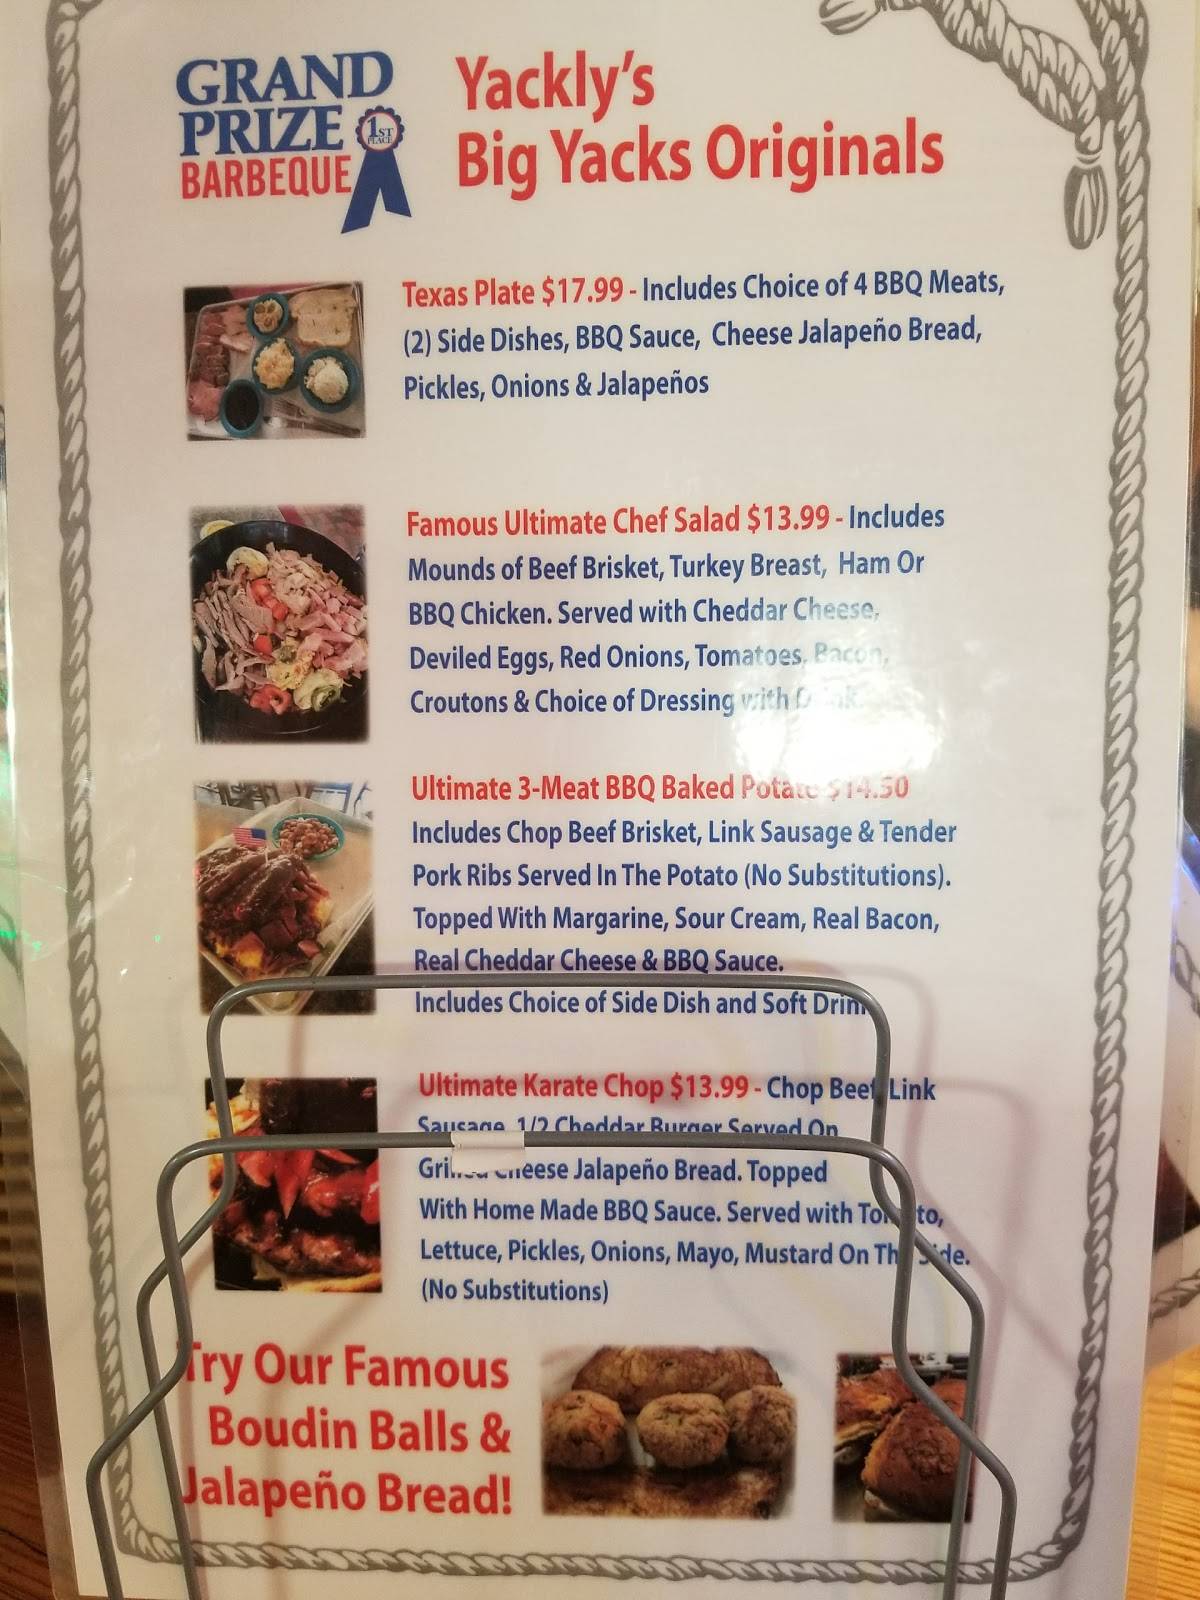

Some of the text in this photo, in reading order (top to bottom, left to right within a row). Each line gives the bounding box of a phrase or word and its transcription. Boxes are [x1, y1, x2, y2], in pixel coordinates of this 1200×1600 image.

[177, 51, 393, 105] GRAND
[456, 50, 654, 123] Yackly's
[179, 105, 343, 156] PRIZE
[459, 117, 944, 201] Big Yacks Originals
[182, 155, 351, 199] BARBEQUE
[402, 281, 468, 307] Texas
[475, 278, 534, 305] Plate
[543, 276, 623, 307] $17.99
[644, 275, 736, 301] Includes
[744, 273, 819, 298] Choice
[826, 271, 848, 296] of
[854, 272, 867, 295] 4
[875, 270, 922, 297] BBQ
[930, 270, 1004, 295] Meats,
[404, 315, 981, 357] (2) Side Dishes, BBQ Sauce, Cheese Jalapeño Bread,
[405, 370, 708, 402] Pickles, Onions & Jalapeños
[408, 512, 498, 536] Famous
[505, 509, 606, 535] Ultimate
[614, 506, 668, 533] Chef
[675, 504, 739, 532] Salad
[748, 503, 829, 534] $13.99
[850, 503, 944, 528] Includes
[409, 550, 924, 583] Mounds of Beef Brisket, Turkey Breast, Ham Or
[410, 596, 879, 628] BBQ Chicken. Served with Cheddar Cheese,
[411, 641, 889, 675] Deviled Eggs, Red Onions, Tomatoes, Bacon,
[411, 690, 508, 713] Croutons
[514, 690, 529, 712] &
[536, 689, 607, 712] Choice
[613, 688, 635, 712] of
[641, 688, 734, 717] Dressing
[741, 686, 790, 711] with
[413, 775, 511, 800] Ultimate
[519, 776, 599, 800] 3-Meat
[607, 775, 655, 803] BBQ
[663, 774, 734, 799] Baked
[413, 819, 956, 849] Includes Chop Beef Brisket, Link Sausage & Tender
[414, 863, 950, 890] Pork Ribs Served In The Potato (No Substitutions).
[413, 905, 939, 935] Topped With Margarine, Sour Cream, Real Bacon,
[415, 948, 783, 974] Real Cheddar Cheese & BBQ Sauce.
[416, 990, 867, 1015] Includes Choice of Side Dish and Soft Drin
[419, 1072, 517, 1096] Ultimate
[523, 1073, 598, 1097] Karate
[604, 1072, 664, 1104] Chop
[671, 1072, 749, 1101] $13.99
[767, 1076, 823, 1105] Chop
[889, 1077, 936, 1100] Link
[555, 1115, 645, 1133] Cheddar
[728, 1118, 802, 1135] Served
[808, 1118, 838, 1137] On
[574, 1157, 668, 1185] Jalapeño
[675, 1159, 742, 1181] Bread.
[747, 1160, 827, 1187] Topped
[419, 1197, 944, 1227] With Home Made BBQ Sauce. Served with Toto,
[421, 1239, 502, 1263] Lettuce,
[509, 1239, 585, 1264] Pickles,
[591, 1240, 670, 1265] Onions,
[678, 1241, 739, 1269] Mayo,
[746, 1242, 832, 1264] Mustard
[839, 1244, 868, 1264] On
[874, 1243, 899, 1265] Th
[423, 1278, 608, 1304] (No Substitutions)
[255, 1343, 332, 1385] Our
[345, 1345, 509, 1389] Famous
[209, 1406, 511, 1453] Boudin Balls &
[182, 1464, 512, 1517] Jalapeño Bread!
